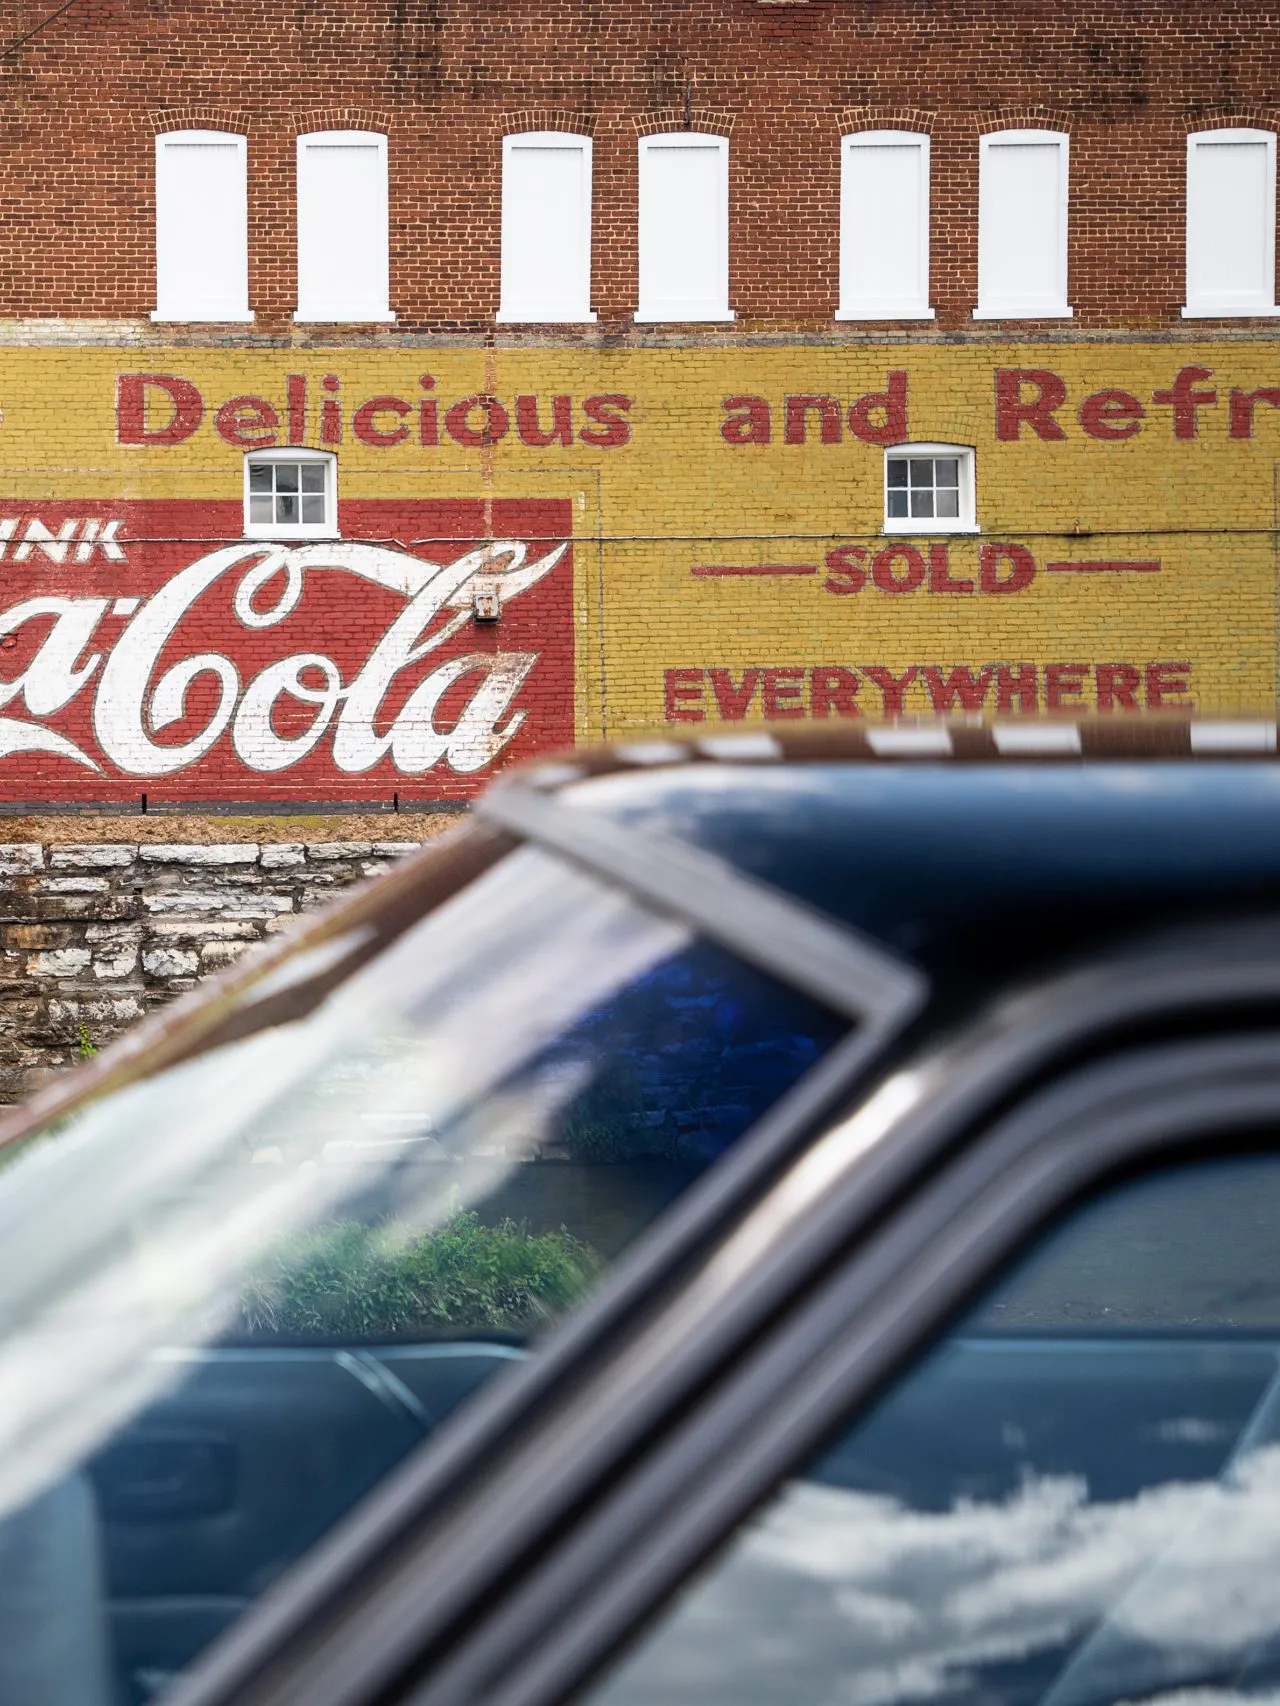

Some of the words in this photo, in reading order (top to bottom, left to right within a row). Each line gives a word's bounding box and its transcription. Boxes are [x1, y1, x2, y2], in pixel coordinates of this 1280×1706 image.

[116, 373, 634, 448] Delicious
[721, 369, 909, 445] and
[824, 544, 1035, 594] SOLD
[664, 664, 1193, 721] EVERYWHERE
